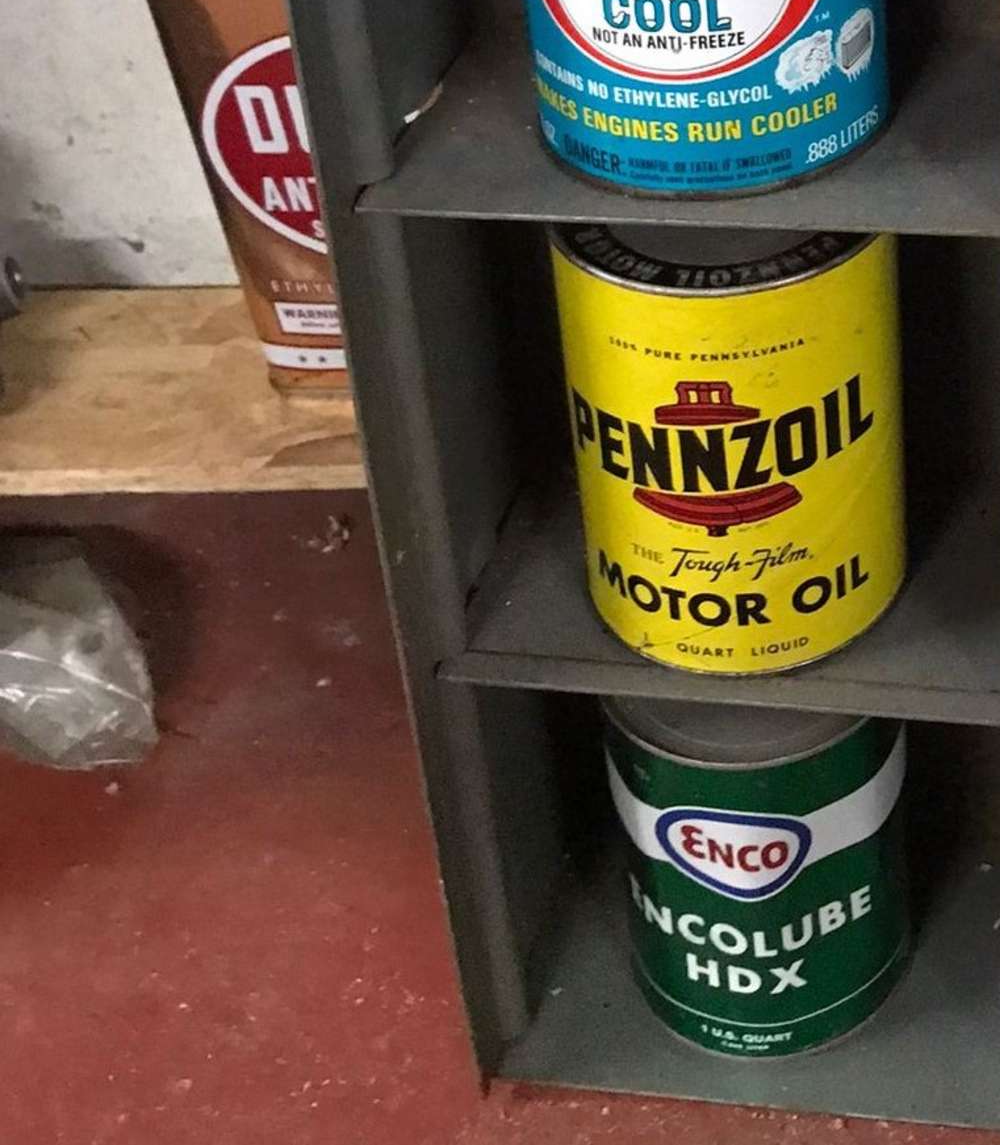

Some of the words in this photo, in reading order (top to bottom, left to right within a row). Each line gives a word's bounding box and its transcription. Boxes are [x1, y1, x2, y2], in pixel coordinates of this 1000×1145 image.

[592, 26, 618, 45] NOT
[622, 31, 643, 49] AN
[646, 30, 746, 51] ANTI-FREEZE
[587, 79, 609, 100] NO
[613, 83, 773, 110] ETHYLENE-GLYCOL
[582, 106, 679, 143] ENGINES
[687, 120, 742, 144] RUN
[751, 91, 838, 137] COOLER
[644, 347, 682, 361] PURE
[690, 337, 805, 362] PENNSYLVANIA
[572, 374, 874, 492] PENNZOIL
[631, 543, 664, 564] THE
[599, 549, 771, 627] MOTOR
[792, 553, 870, 615] OIL
[677, 642, 734, 657] QUART
[751, 636, 809, 656] LIQUID
[680, 825, 789, 872] ENCO
[686, 953, 807, 995] HDX
[742, 1032, 792, 1044] QUART
